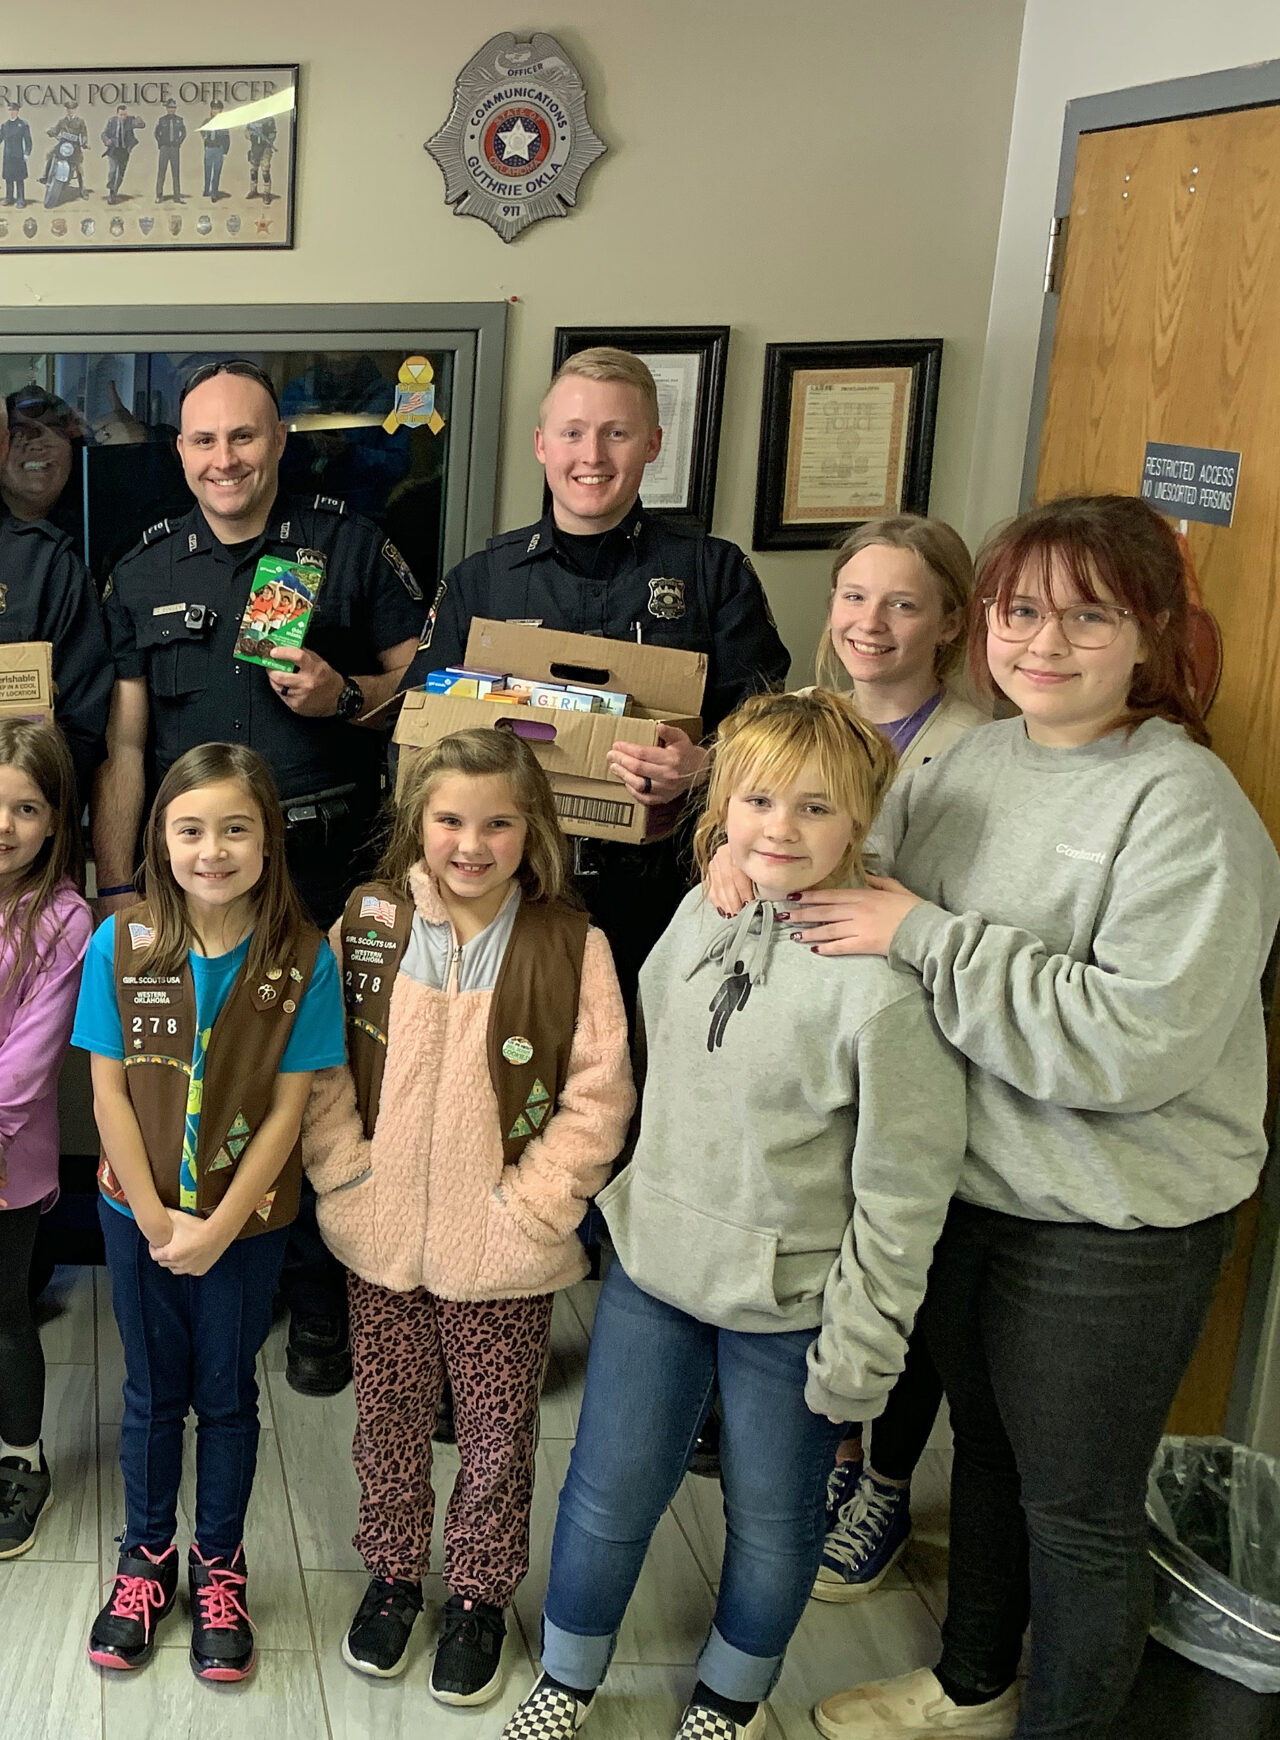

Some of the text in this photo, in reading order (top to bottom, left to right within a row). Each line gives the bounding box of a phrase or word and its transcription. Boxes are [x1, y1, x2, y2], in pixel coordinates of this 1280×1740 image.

[508, 63, 543, 76] OFFICER
[88, 82, 172, 105] POLICE
[179, 80, 277, 103] OFFICER
[471, 88, 568, 129] COMMUNICATIONS
[468, 156, 562, 196] GUTHRIE OKLA
[502, 206, 520, 216] 911
[1145, 457, 1235, 487] RESTRICTED ACCESS
[1142, 480, 1232, 511] NO UNESCORTED PERSONS
[358, 937, 384, 948] SCOUTS
[384, 941, 397, 949] USA
[122, 976, 181, 984] GIRL SCOUTS USA
[132, 1016, 177, 1034] 278
